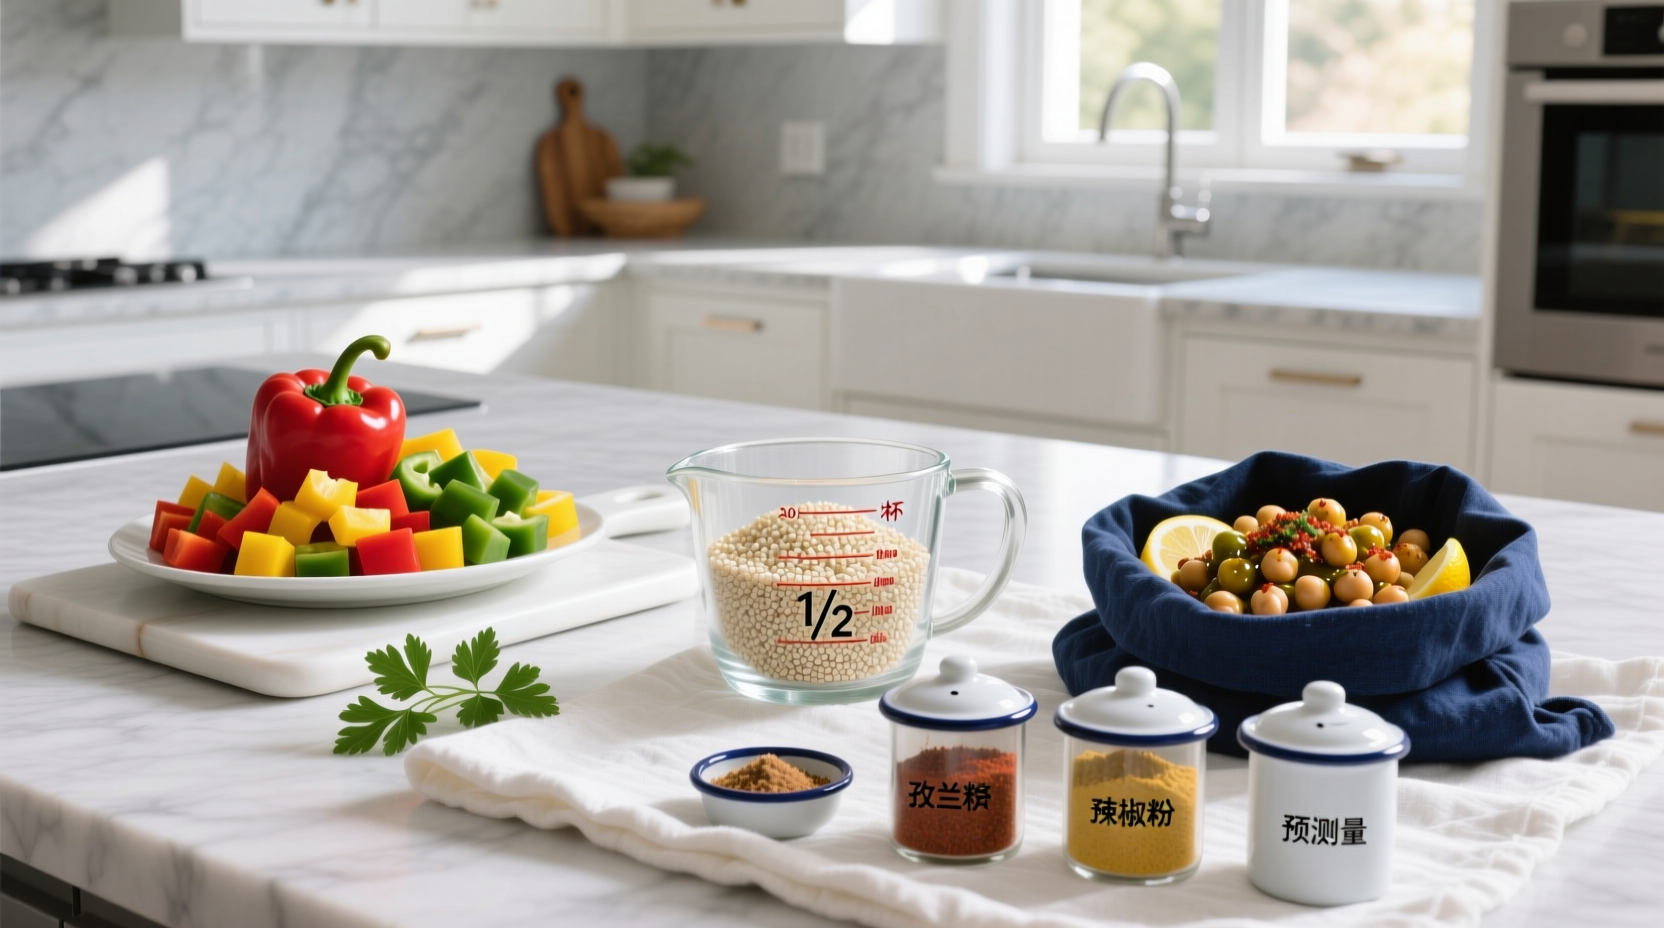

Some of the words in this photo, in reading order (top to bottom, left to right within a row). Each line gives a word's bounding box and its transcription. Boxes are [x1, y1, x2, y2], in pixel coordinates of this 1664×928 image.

[797, 589, 853, 641] 1/2
[1281, 814, 1368, 847] 预测量
